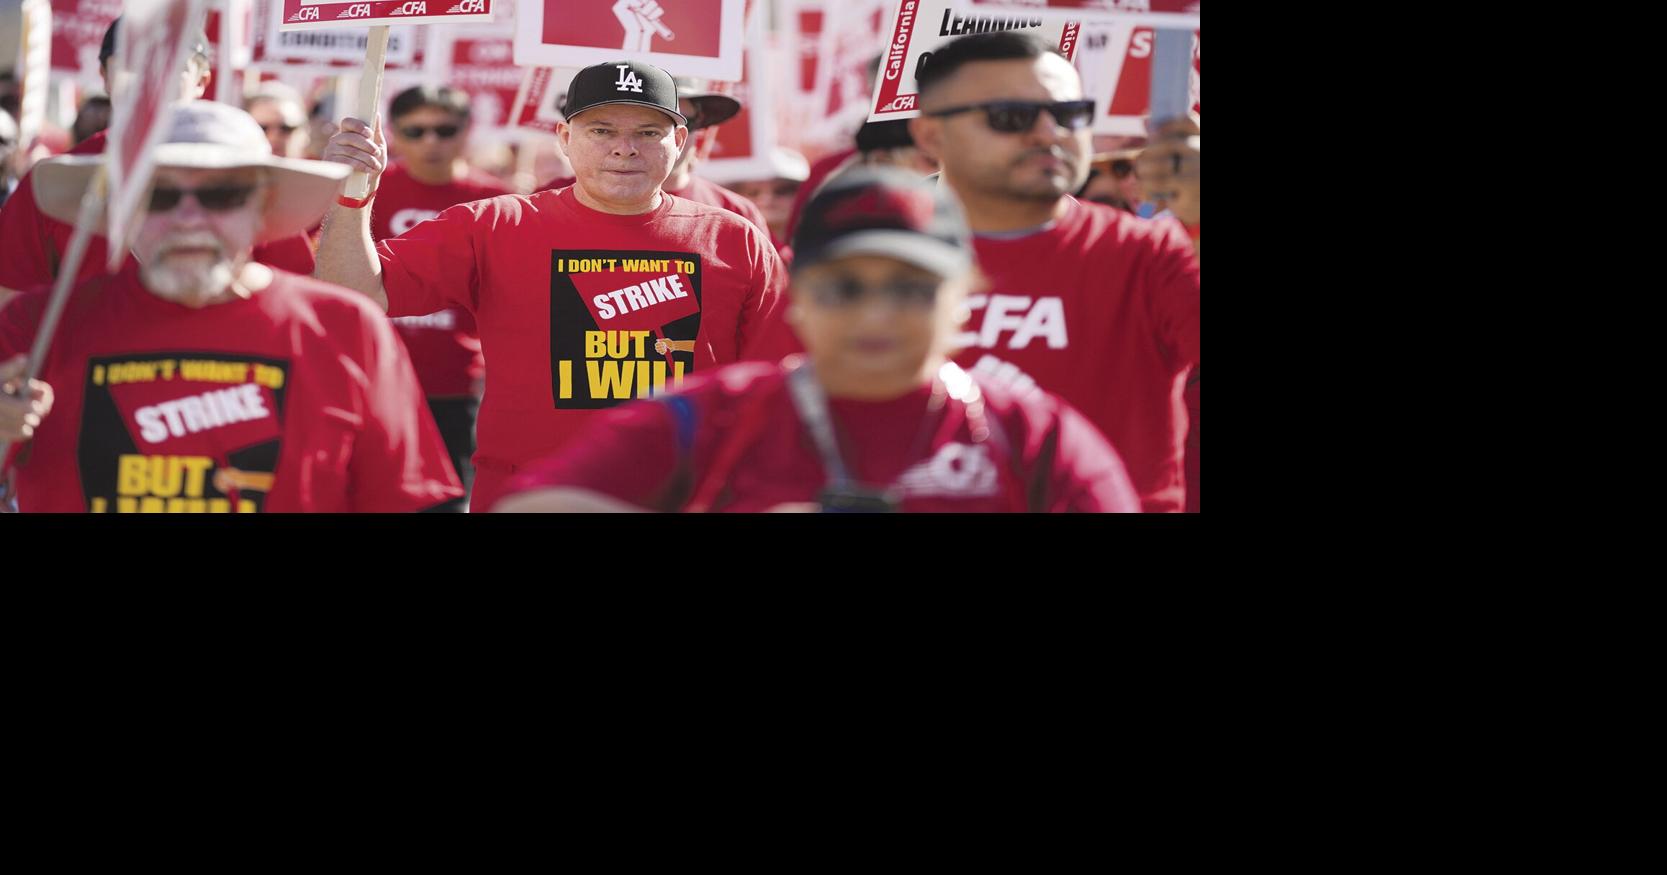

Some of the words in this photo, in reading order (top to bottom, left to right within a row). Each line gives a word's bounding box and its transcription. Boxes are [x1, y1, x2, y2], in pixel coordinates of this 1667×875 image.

[298, 7, 319, 20] CFA
[347, 4, 370, 17] CFA
[402, 1, 426, 14] CFA
[459, 0, 484, 12] CFA
[886, 1, 915, 80] California
[615, 65, 643, 93] LA
[892, 96, 915, 110] CFA
[558, 259, 564, 272] I
[568, 259, 616, 272] DON'T
[622, 259, 669, 272] WANT
[675, 260, 695, 274] TO
[593, 274, 688, 319] STRIKE
[585, 330, 650, 358] BUT
[559, 360, 572, 399] I
[134, 383, 270, 443] STRIKE
[117, 454, 213, 497] BUT
